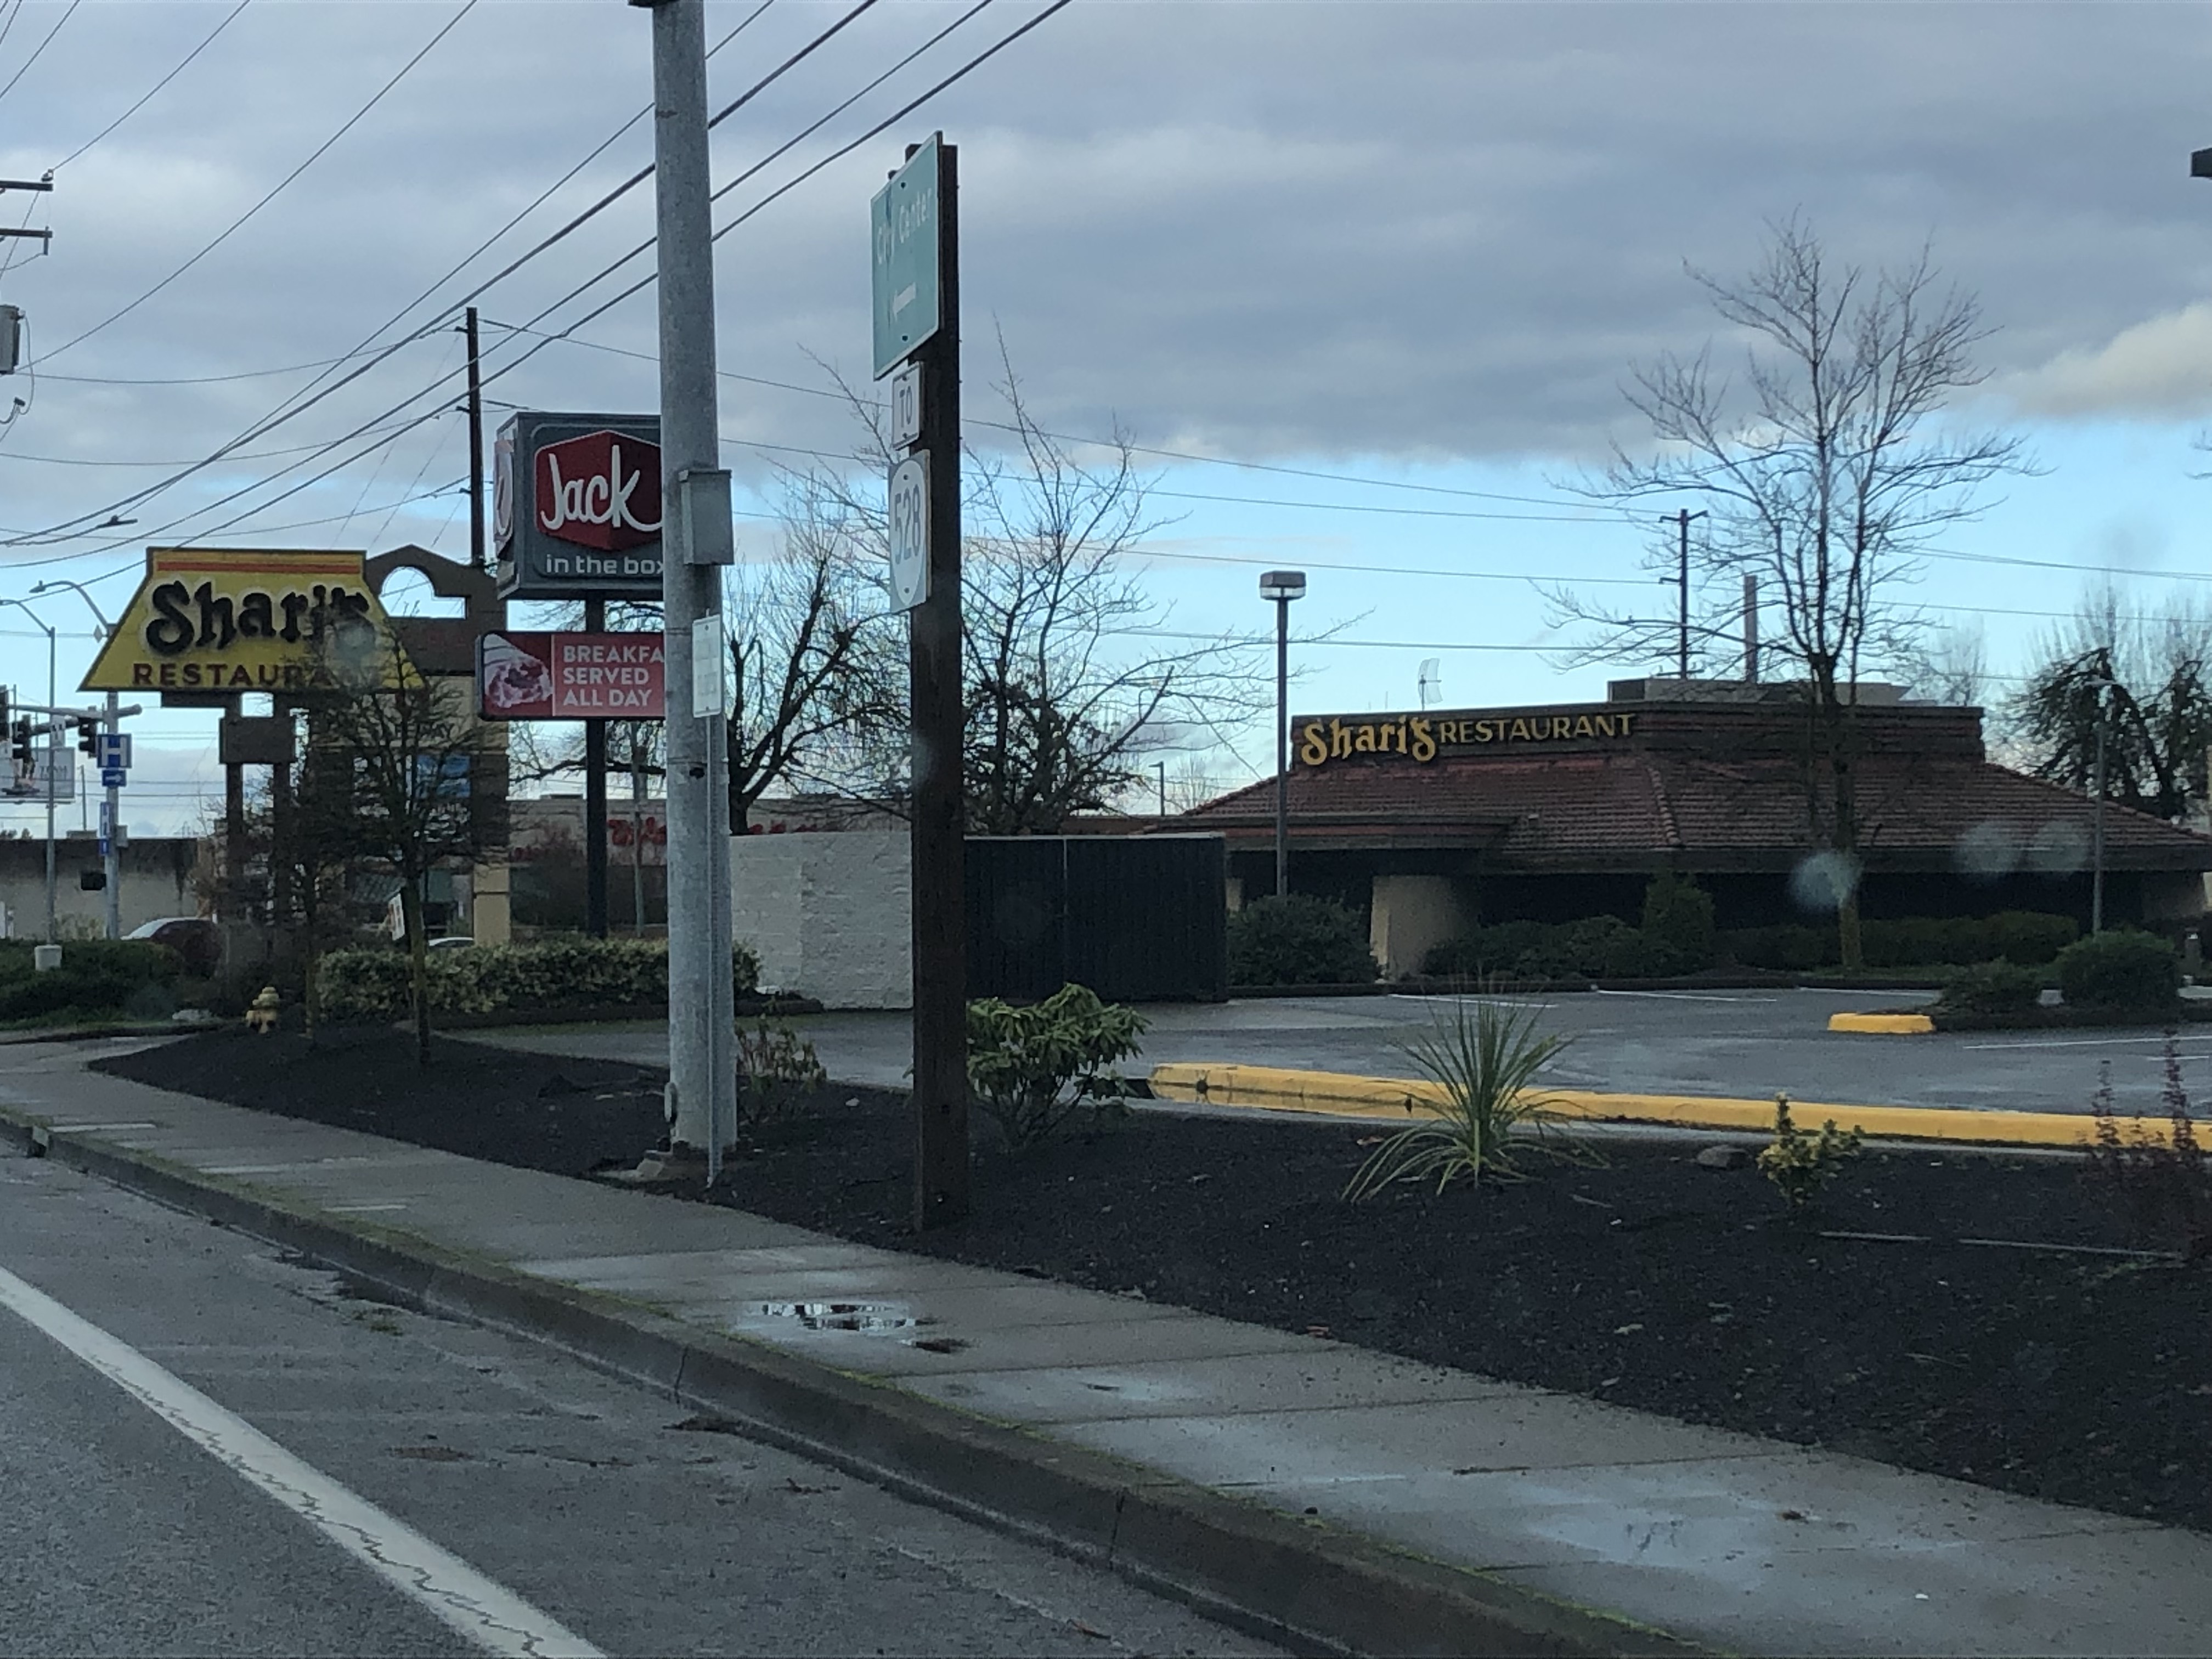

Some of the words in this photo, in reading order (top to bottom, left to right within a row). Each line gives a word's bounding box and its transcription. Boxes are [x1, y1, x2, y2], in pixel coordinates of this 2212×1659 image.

[899, 187, 932, 245] Center
[899, 385, 913, 428] TO
[540, 444, 663, 532] Jack
[895, 484, 921, 565] 528
[547, 554, 569, 573] in
[575, 555, 617, 574] the
[563, 645, 665, 663] BREAKFA
[132, 662, 380, 687] RESTAURA
[563, 667, 649, 685] SERVED
[563, 689, 602, 707] ALL
[608, 689, 652, 707] DAY
[1440, 714, 1635, 743] RESTAURANT
[101, 736, 127, 766] H
